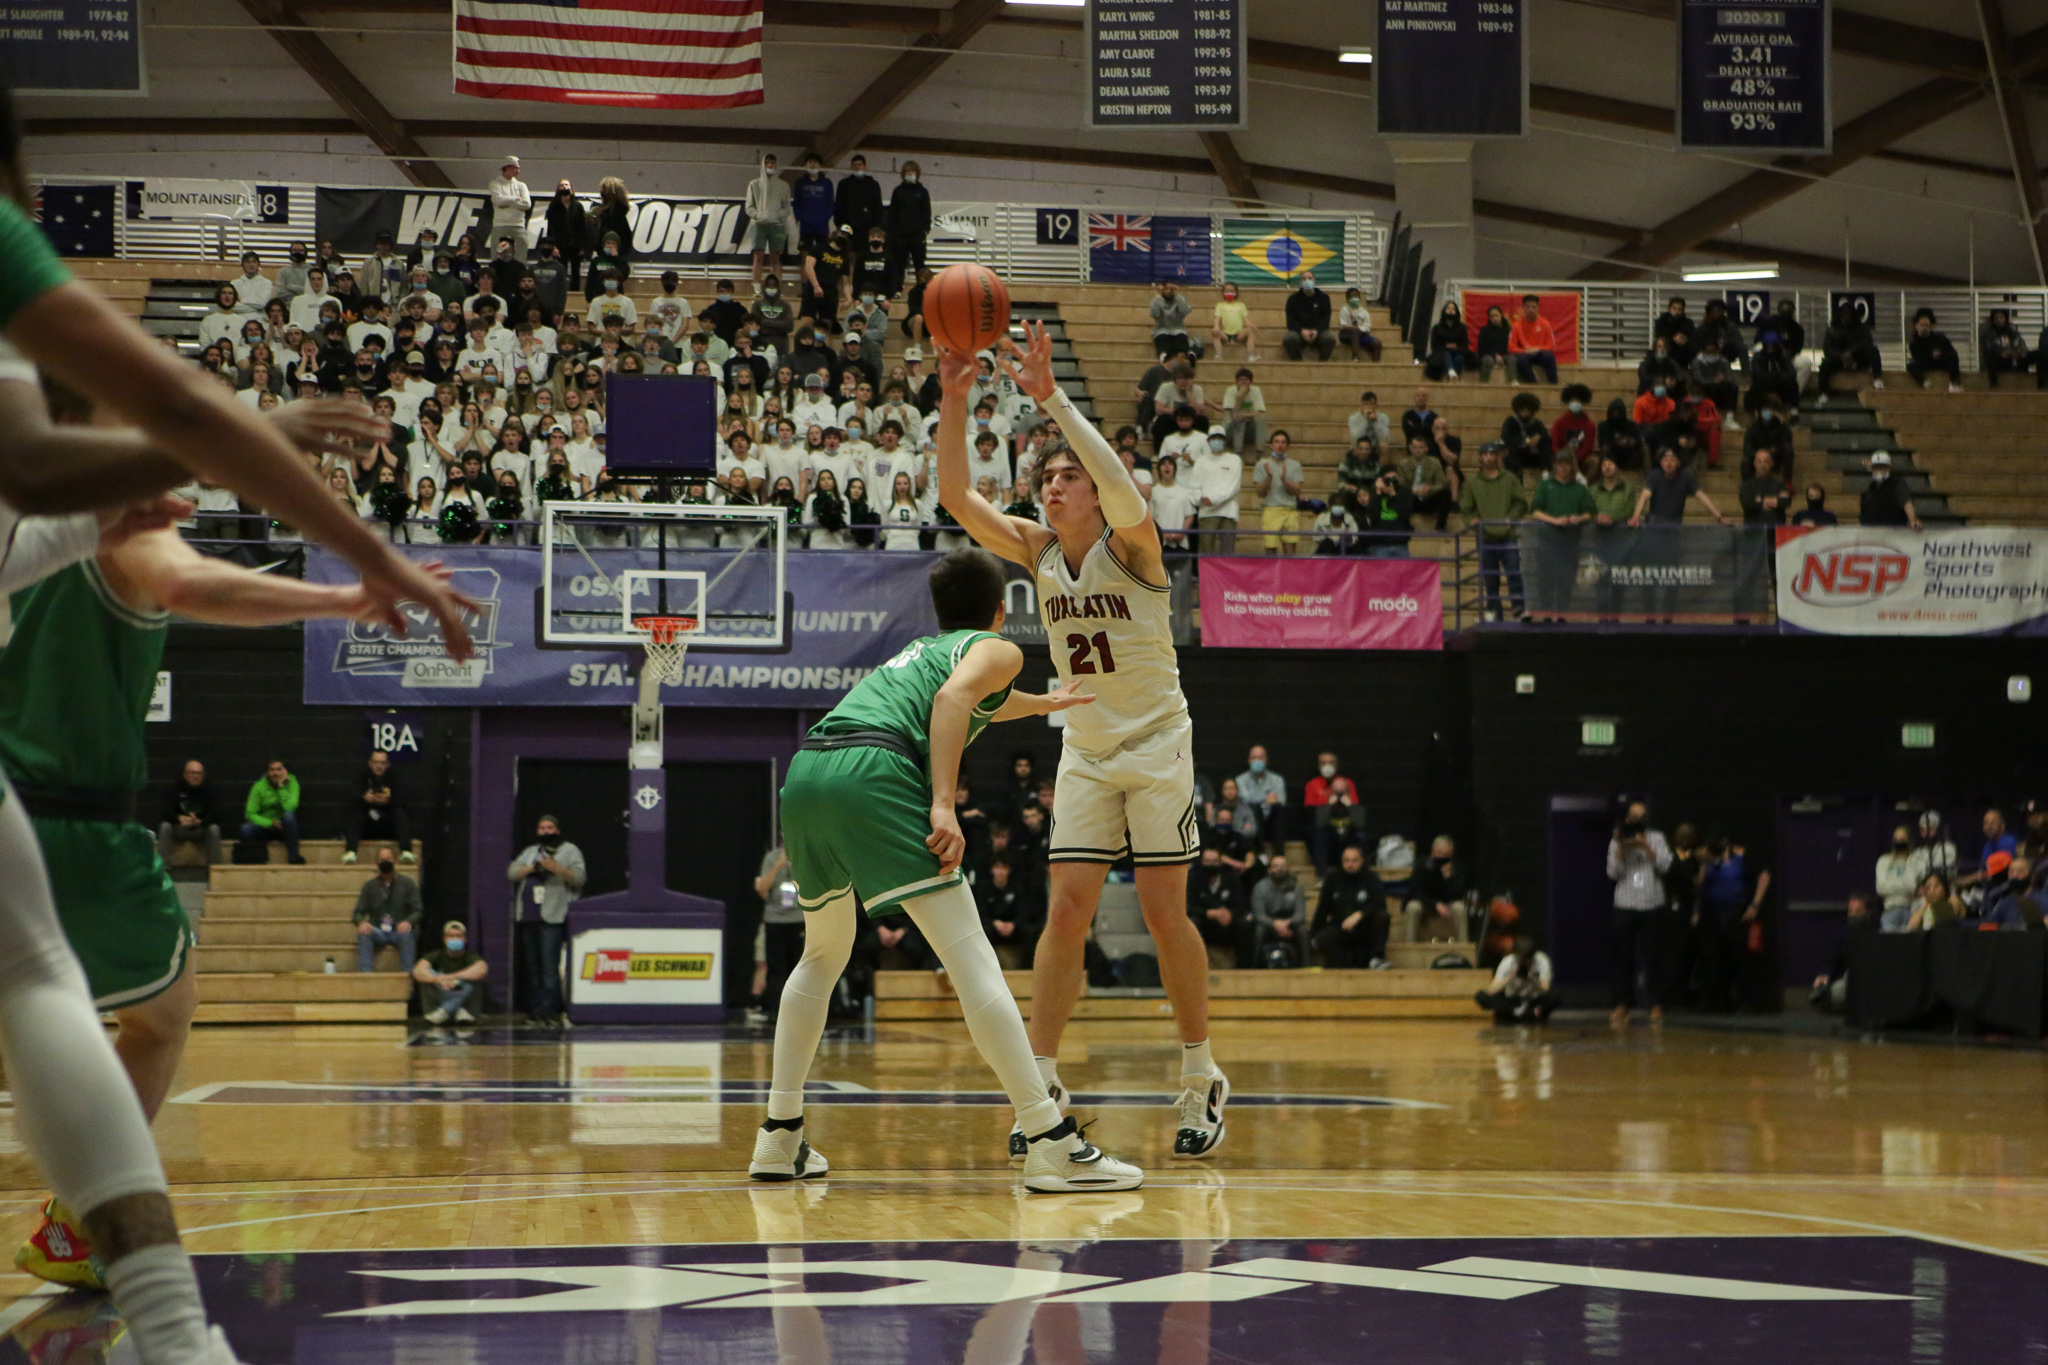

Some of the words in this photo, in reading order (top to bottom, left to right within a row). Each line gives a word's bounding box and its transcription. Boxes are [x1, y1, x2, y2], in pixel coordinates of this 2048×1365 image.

[1385, 1, 1402, 12] KAT
[1404, 2, 1447, 13] MARTINEZ
[1478, 3, 1513, 14] 1983-86
[11, 9, 64, 21] SLAUGHTER
[88, 10, 128, 22] 1978-82
[1099, 11, 1128, 22] KARYL
[1129, 11, 1155, 22] WING
[1194, 10, 1231, 20] 1981-85
[1726, 12, 1780, 25] 2020-21
[1385, 20, 1405, 30] ANN
[1407, 20, 1457, 31] PINKOWSKI
[1478, 21, 1513, 33] 1989-92
[13, 29, 43, 40] HOULE
[101, 30, 129, 41] 92-94
[1100, 30, 1137, 41] MARTHA
[1139, 29, 1179, 40] SHELDON
[1194, 29, 1231, 39] 1988-92
[1713, 33, 1766, 44] AVERAGE
[1769, 34, 1794, 45] GPA
[1099, 49, 1120, 59] AMY
[1122, 48, 1155, 59] CLABOE
[1194, 47, 1231, 58] 1992-95
[1731, 46, 1772, 63] 3.41
[1100, 67, 1129, 78] LAURA
[1131, 67, 1151, 77] SALE
[1194, 66, 1232, 77] 1992-96
[1719, 66, 1762, 77] DEAN'S
[1766, 67, 1787, 77] LIST
[1100, 86, 1129, 96] DEANA
[1132, 85, 1170, 96] LANSING
[1194, 85, 1232, 96] 1993-97
[1730, 79, 1775, 96] 48%
[1100, 104, 1135, 115] KRISTIN
[1137, 104, 1171, 115] HEPTON
[1194, 103, 1232, 115] 1995-99
[1703, 100, 1775, 111] GRADUATION
[1778, 101, 1803, 112] RATE
[1730, 113, 1775, 130] 93%
[1045, 213, 1072, 240] 19
[1736, 294, 1763, 323] 19
[1922, 540, 2033, 559] Northwest
[1611, 565, 1712, 579] MARINES
[1800, 552, 1911, 596] NSP
[1923, 561, 1995, 579] Sports
[1923, 580, 2048, 603] Photograph
[1224, 590, 1248, 602] Kids
[1249, 592, 1274, 603] who
[1275, 592, 1302, 605] play
[1303, 594, 1332, 607] grow
[1369, 595, 1418, 612] moda
[1045, 593, 1132, 627] TUALATIN
[1224, 604, 1247, 614] into
[1248, 605, 1291, 618] healthy
[1293, 606, 1332, 617] adults.
[1877, 609, 1978, 622] www.4nsp.com
[349, 644, 385, 655] STATE
[1066, 630, 1116, 676] 21
[413, 662, 473, 678] OnPoint
[371, 722, 419, 752] 18A
[631, 960, 650, 972] LES
